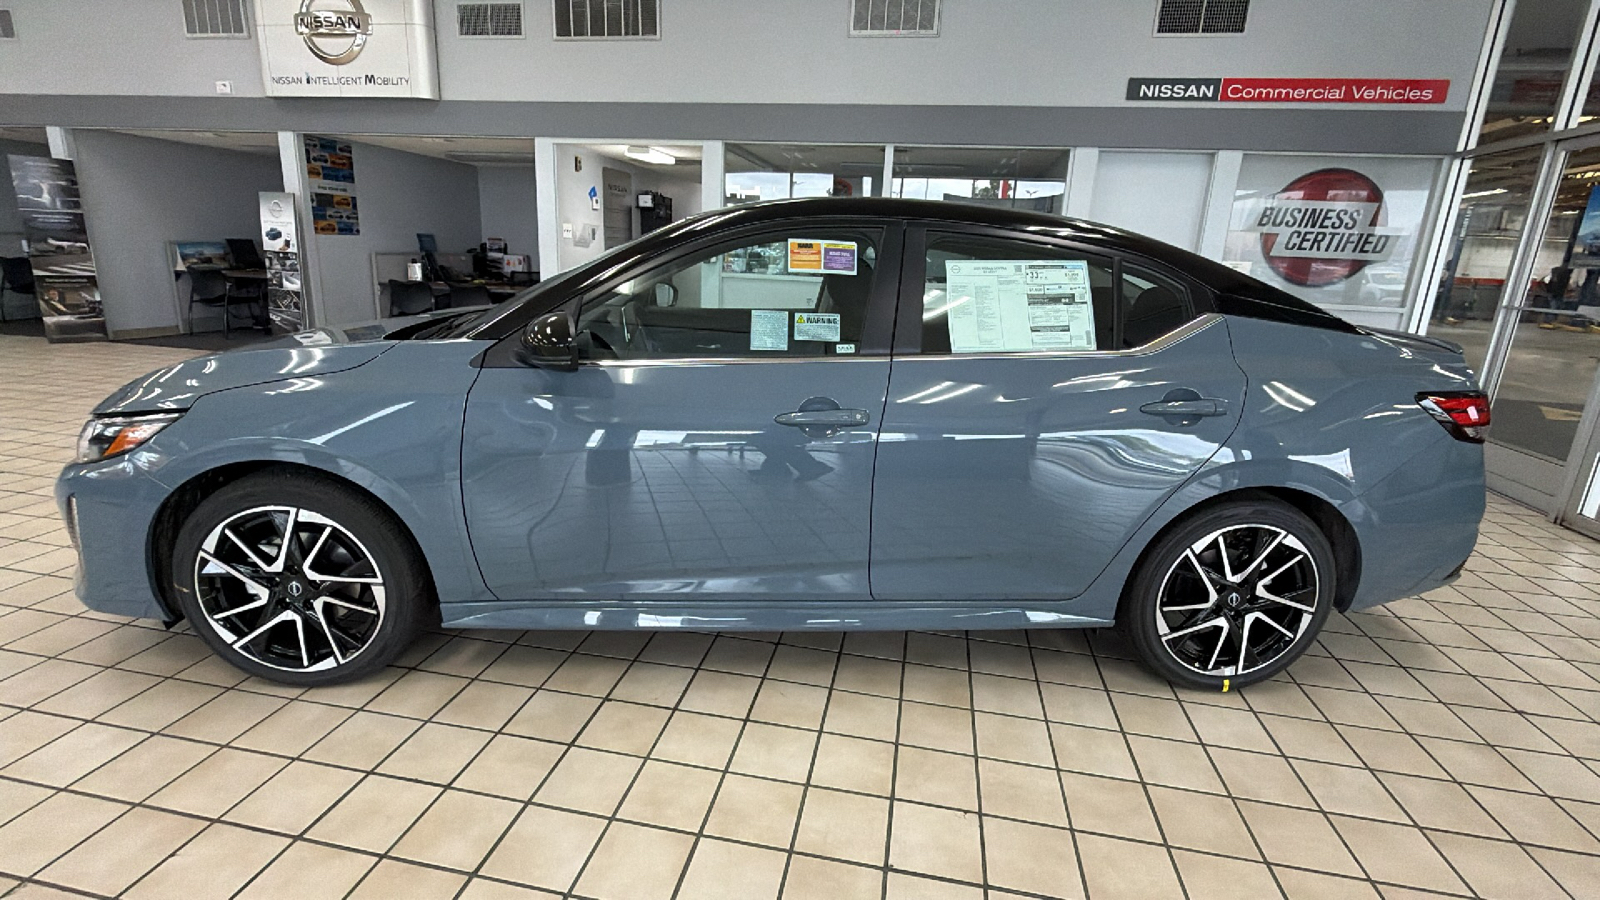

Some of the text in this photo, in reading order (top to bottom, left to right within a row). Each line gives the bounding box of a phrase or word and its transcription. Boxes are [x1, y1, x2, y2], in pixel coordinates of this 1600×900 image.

[299, 16, 361, 29] NISSAN
[272, 76, 302, 85] NISSAN
[364, 75, 410, 85] MOBILITY
[1139, 84, 1433, 100] NISSAN Commercial Vehicles
[1257, 207, 1362, 230] BUSINESS
[1284, 230, 1389, 254] CERTIFIED
